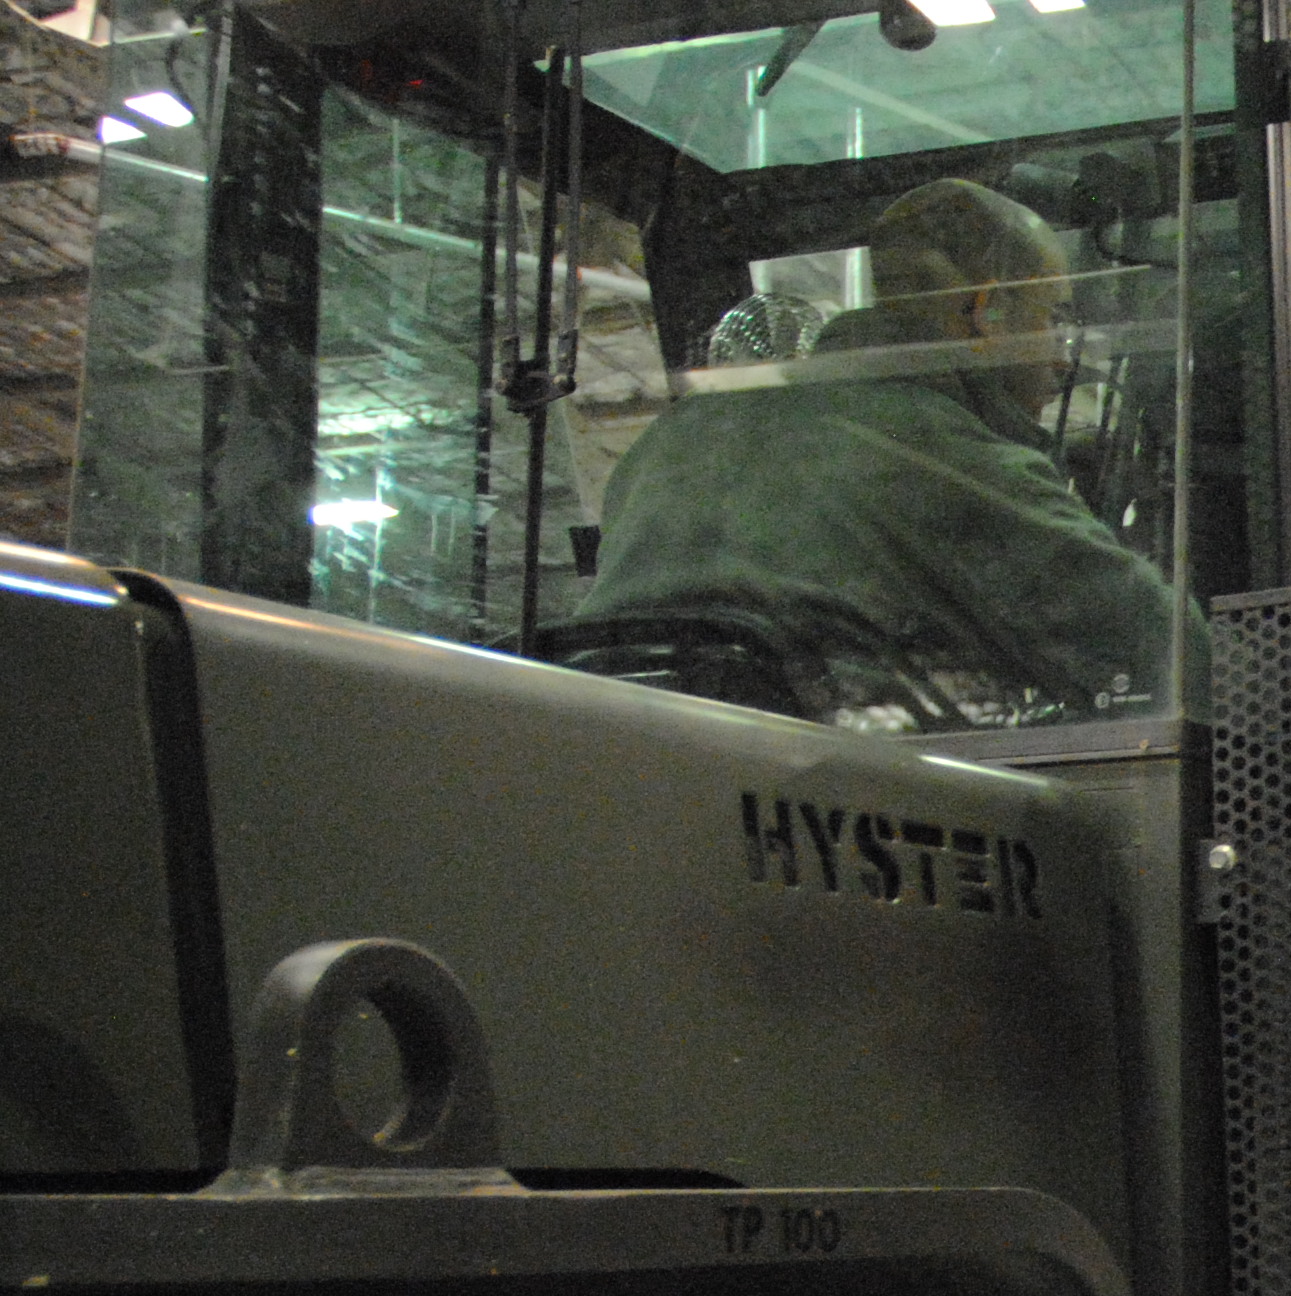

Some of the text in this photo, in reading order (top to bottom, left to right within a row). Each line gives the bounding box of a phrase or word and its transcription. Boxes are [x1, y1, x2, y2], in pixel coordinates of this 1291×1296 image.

[741, 790, 1042, 920] HYSTER
[720, 1206, 841, 1253] TP 100
